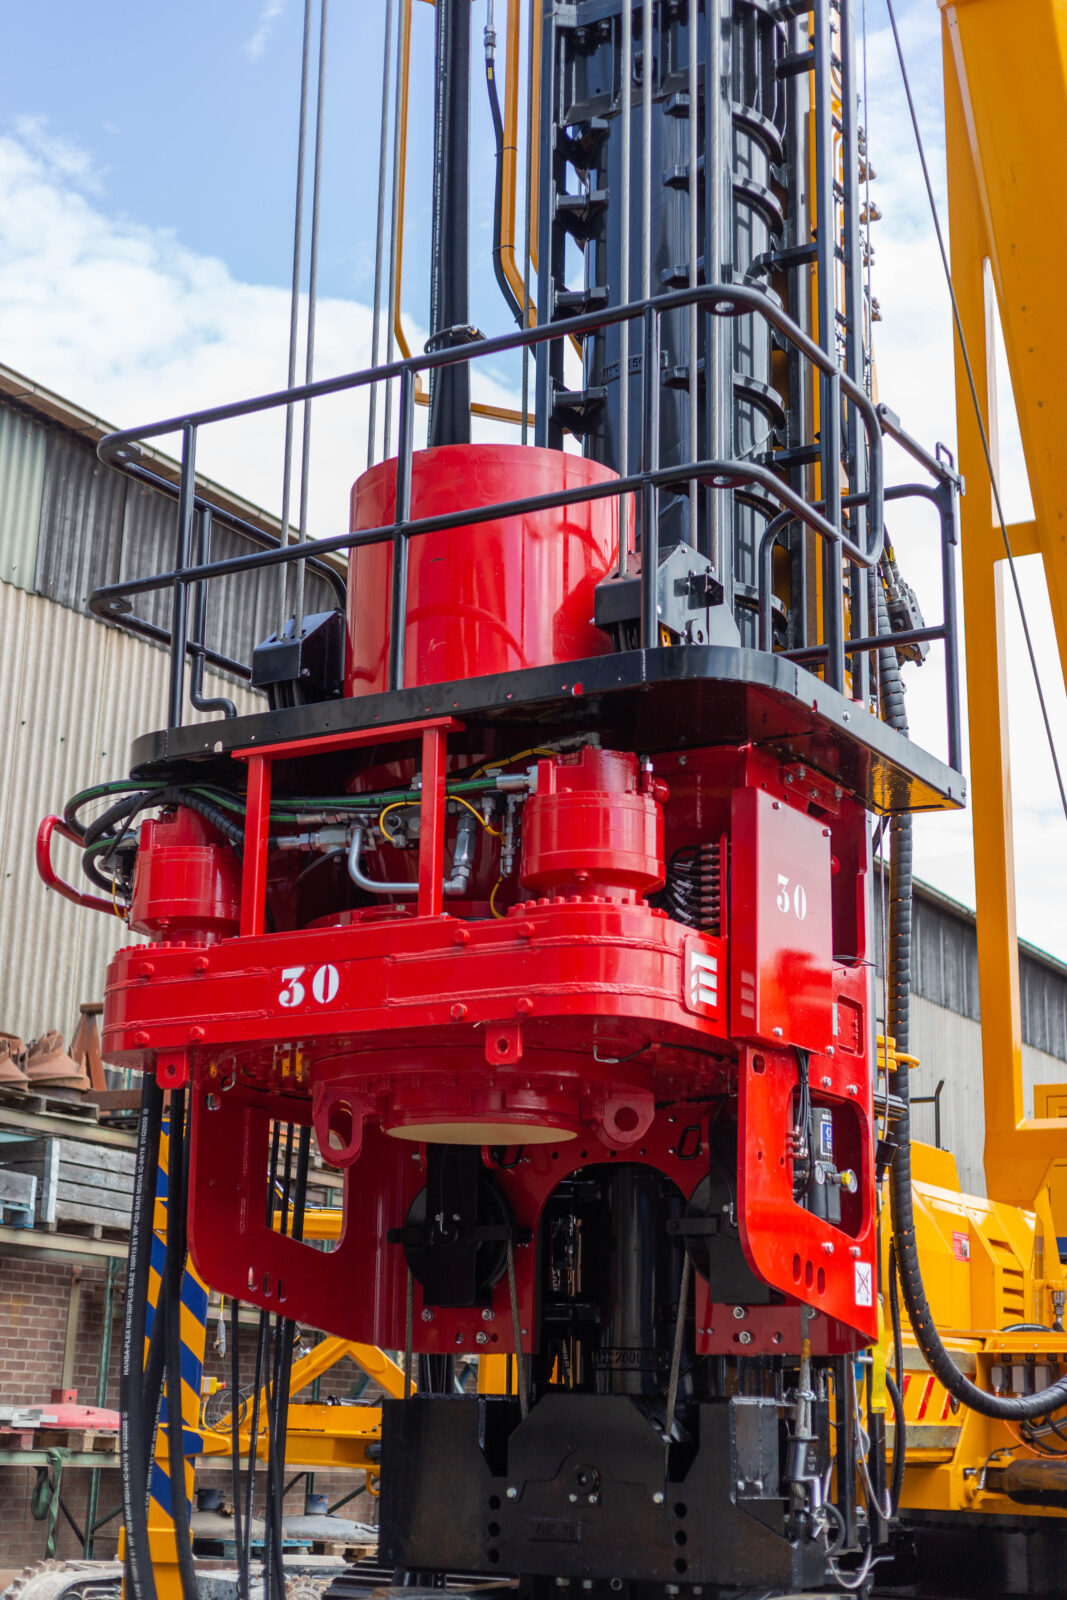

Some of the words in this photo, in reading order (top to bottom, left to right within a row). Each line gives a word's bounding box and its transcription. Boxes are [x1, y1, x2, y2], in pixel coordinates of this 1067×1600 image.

[776, 872, 807, 921] 30
[278, 964, 340, 1008] 30
[132, 1224, 139, 1237] WP
